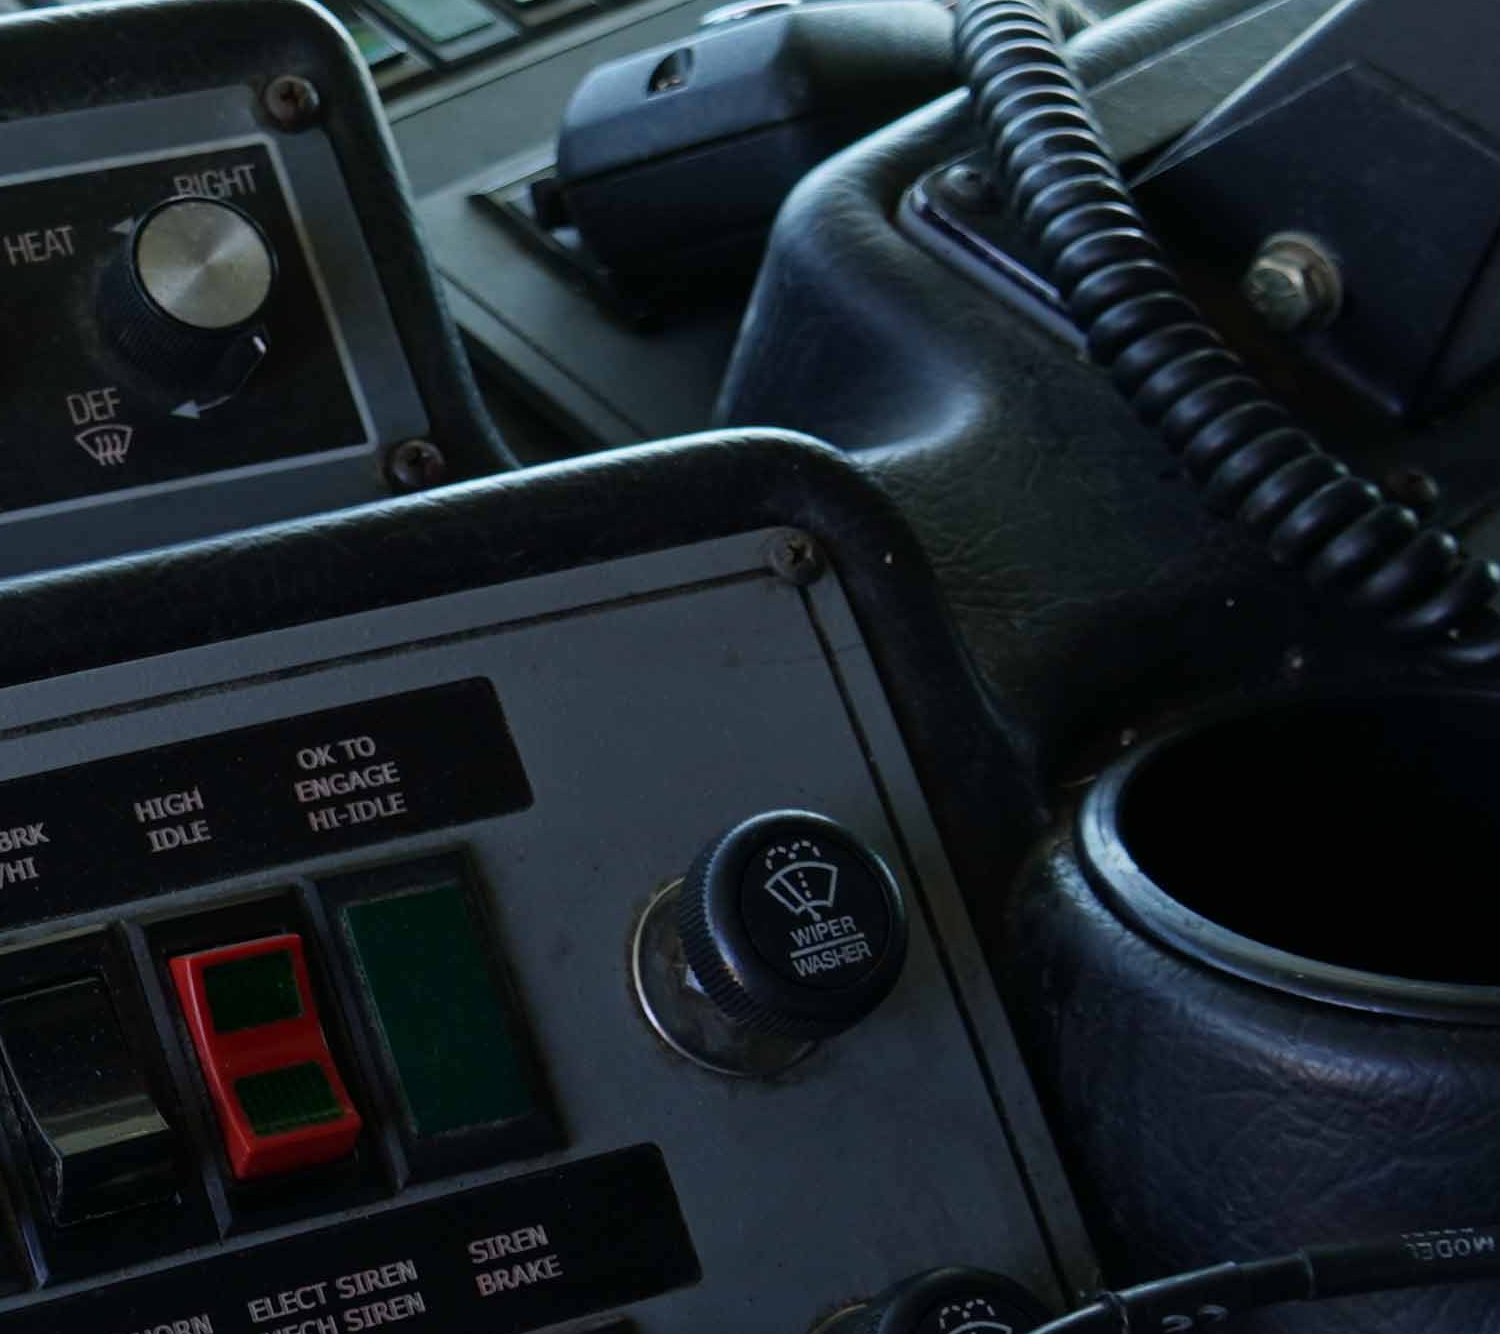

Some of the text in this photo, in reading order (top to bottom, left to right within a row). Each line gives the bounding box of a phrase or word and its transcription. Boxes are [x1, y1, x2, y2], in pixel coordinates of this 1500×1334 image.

[173, 165, 256, 199] RIGHT
[3, 226, 74, 266] HEAT
[66, 388, 121, 426] DEF
[295, 735, 377, 771] OK TO
[294, 761, 401, 804] ENGAGE
[134, 786, 206, 823] HIGH
[307, 791, 408, 833] HI-IDLE
[148, 819, 212, 854] IDLE
[790, 915, 858, 948] WIPER
[793, 940, 873, 977] WASHER
[467, 1223, 550, 1265] SIREN
[1403, 1234, 1497, 1262] MODEL
[247, 1259, 419, 1324] ELECT SIREN
[474, 1253, 564, 1298] BRAKE
[343, 1291, 427, 1333] SIREN
